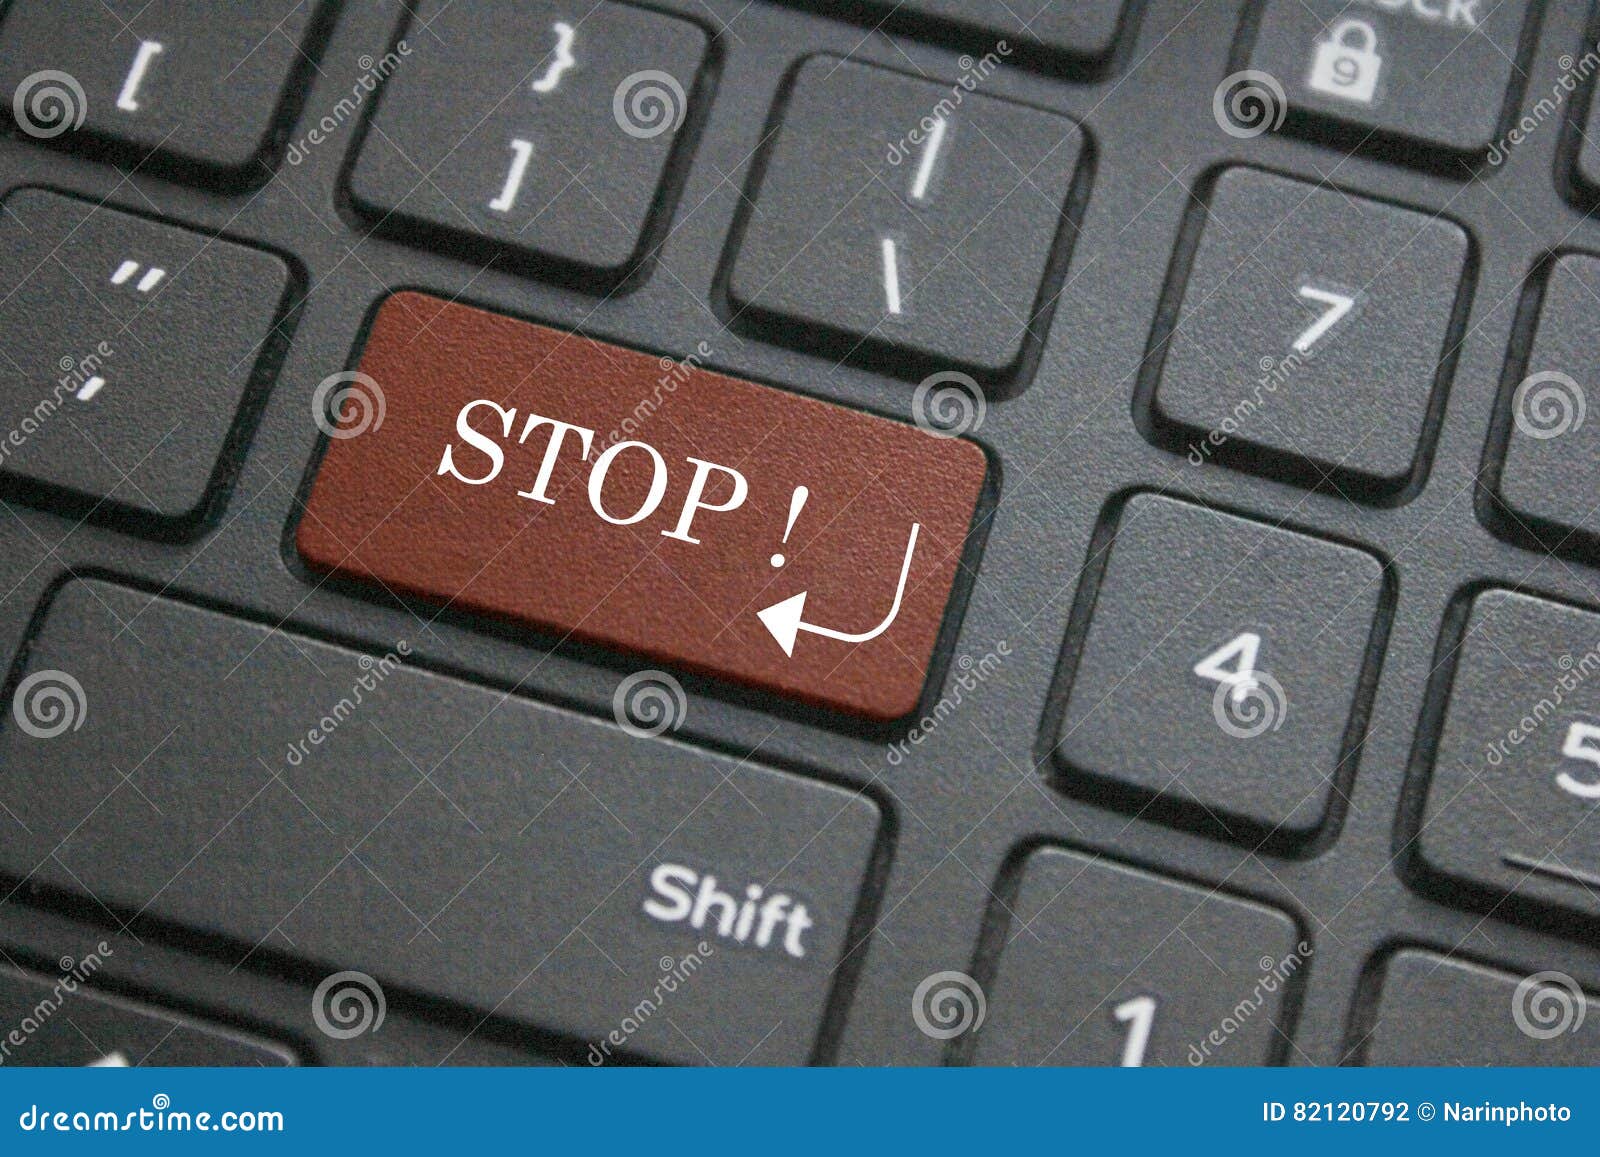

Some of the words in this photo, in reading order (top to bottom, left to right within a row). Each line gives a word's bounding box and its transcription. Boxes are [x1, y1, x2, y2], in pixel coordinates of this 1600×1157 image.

[1332, 56, 1359, 86] 9
[1292, 286, 1354, 351] 7
[437, 399, 748, 545] STOP
[770, 485, 809, 568] !
[1193, 632, 1261, 702] 4
[1556, 722, 1600, 798] 5
[643, 863, 813, 957] Shift
[1114, 996, 1156, 1067] 1
